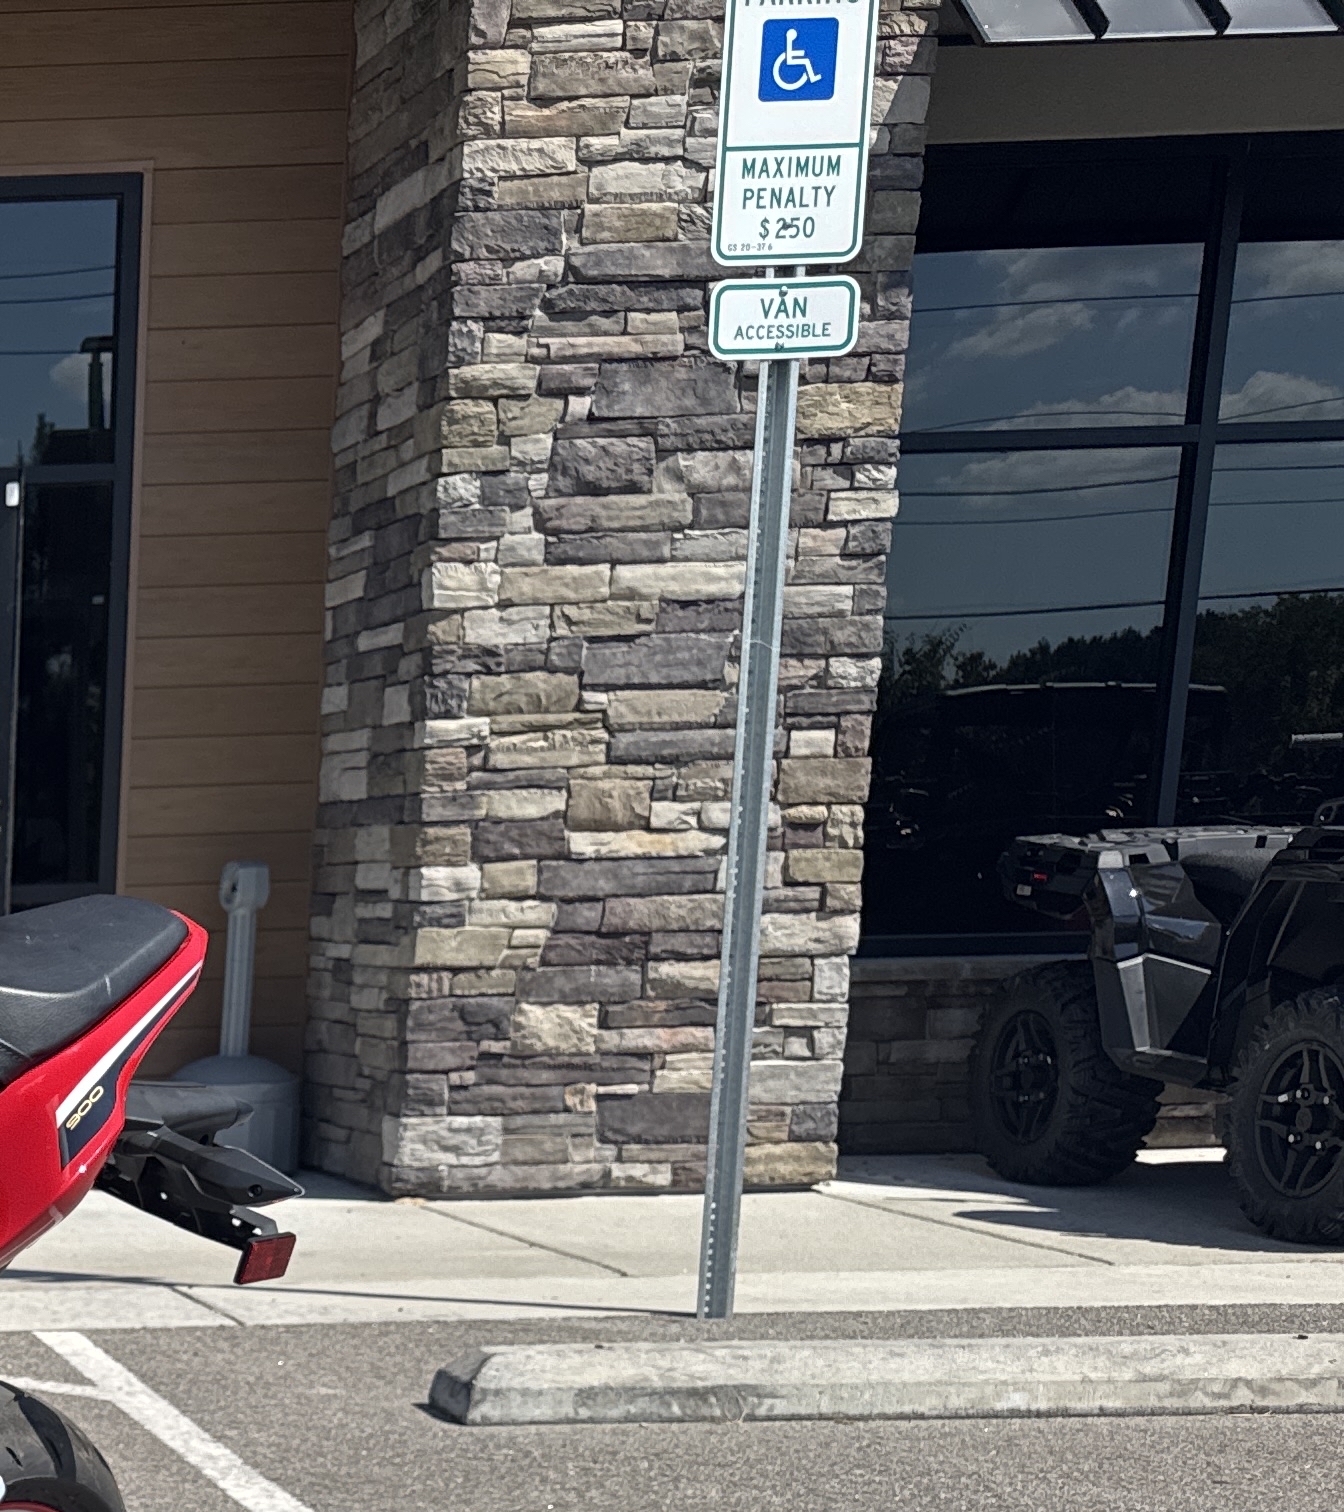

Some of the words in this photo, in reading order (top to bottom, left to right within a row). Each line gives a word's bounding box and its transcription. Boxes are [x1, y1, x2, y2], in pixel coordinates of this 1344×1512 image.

[741, 155, 842, 180] MAXIMUM
[742, 185, 836, 210] PENALTY
[758, 216, 816, 242] $250
[760, 297, 808, 320] VAN
[733, 323, 832, 341] ACCESSIBLE
[65, 1085, 105, 1131] 900
